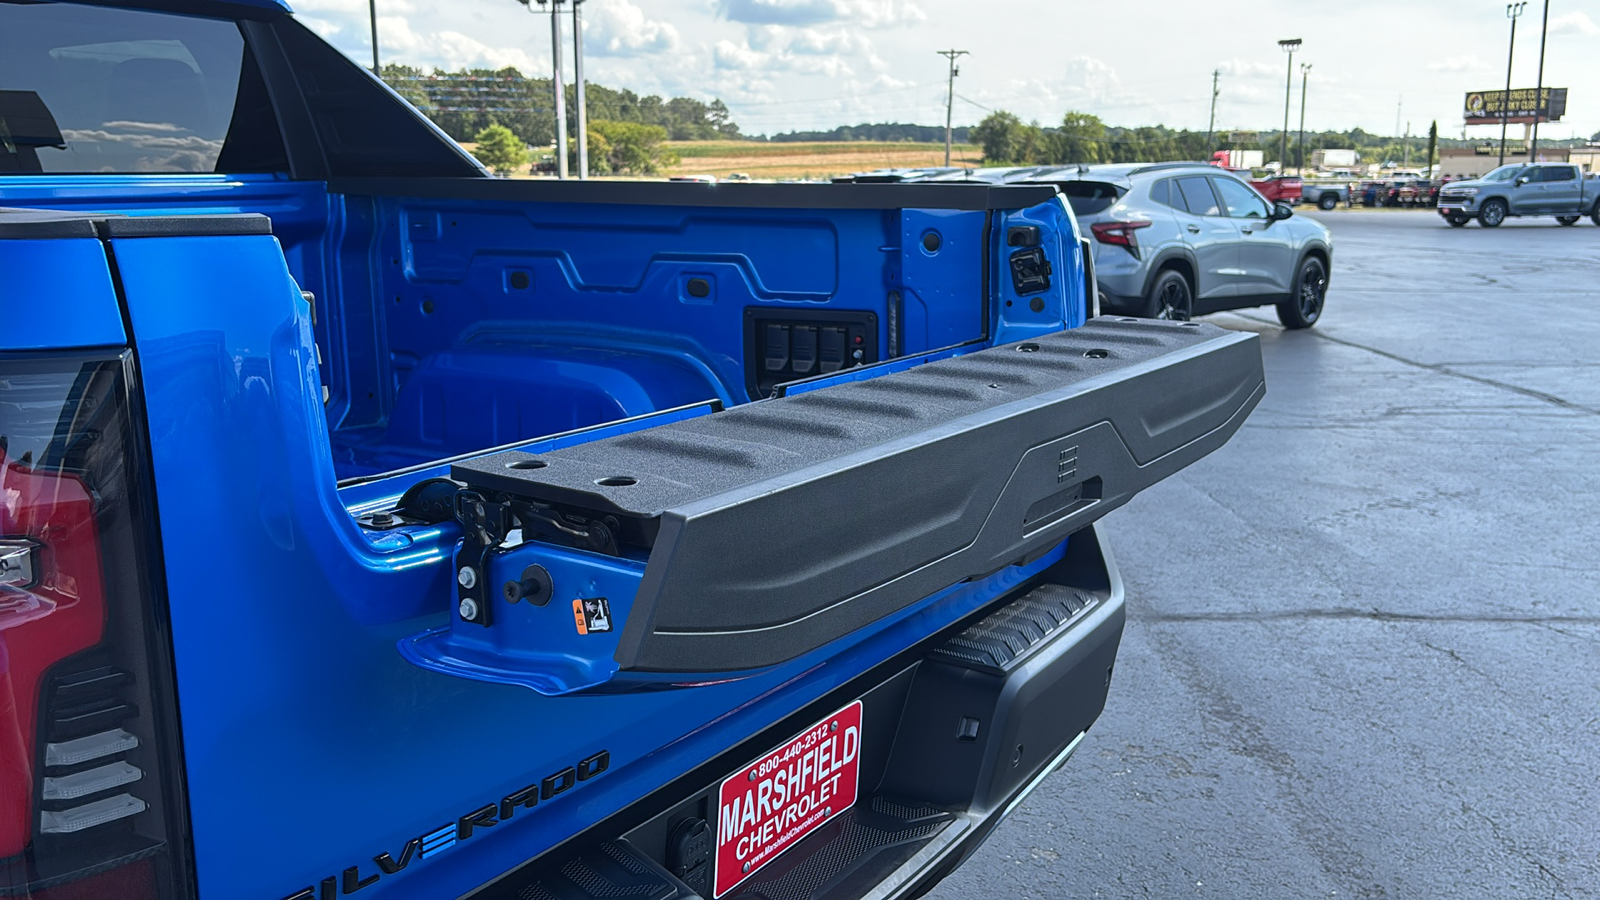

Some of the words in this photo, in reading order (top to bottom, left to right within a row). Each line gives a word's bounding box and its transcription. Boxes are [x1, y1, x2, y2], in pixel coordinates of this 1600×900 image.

[1486, 101, 1500, 112] BUT
[1500, 100, 1520, 111] JRKY
[1521, 99, 1546, 110] CLOSR
[1500, 90, 1527, 101] FENDS
[758, 724, 828, 777] 800-440-2312
[720, 725, 858, 847] MARSHFIELD
[735, 773, 842, 861] CHEVROLET
[750, 808, 825, 866] www.MarshfieldChevrolet.com
